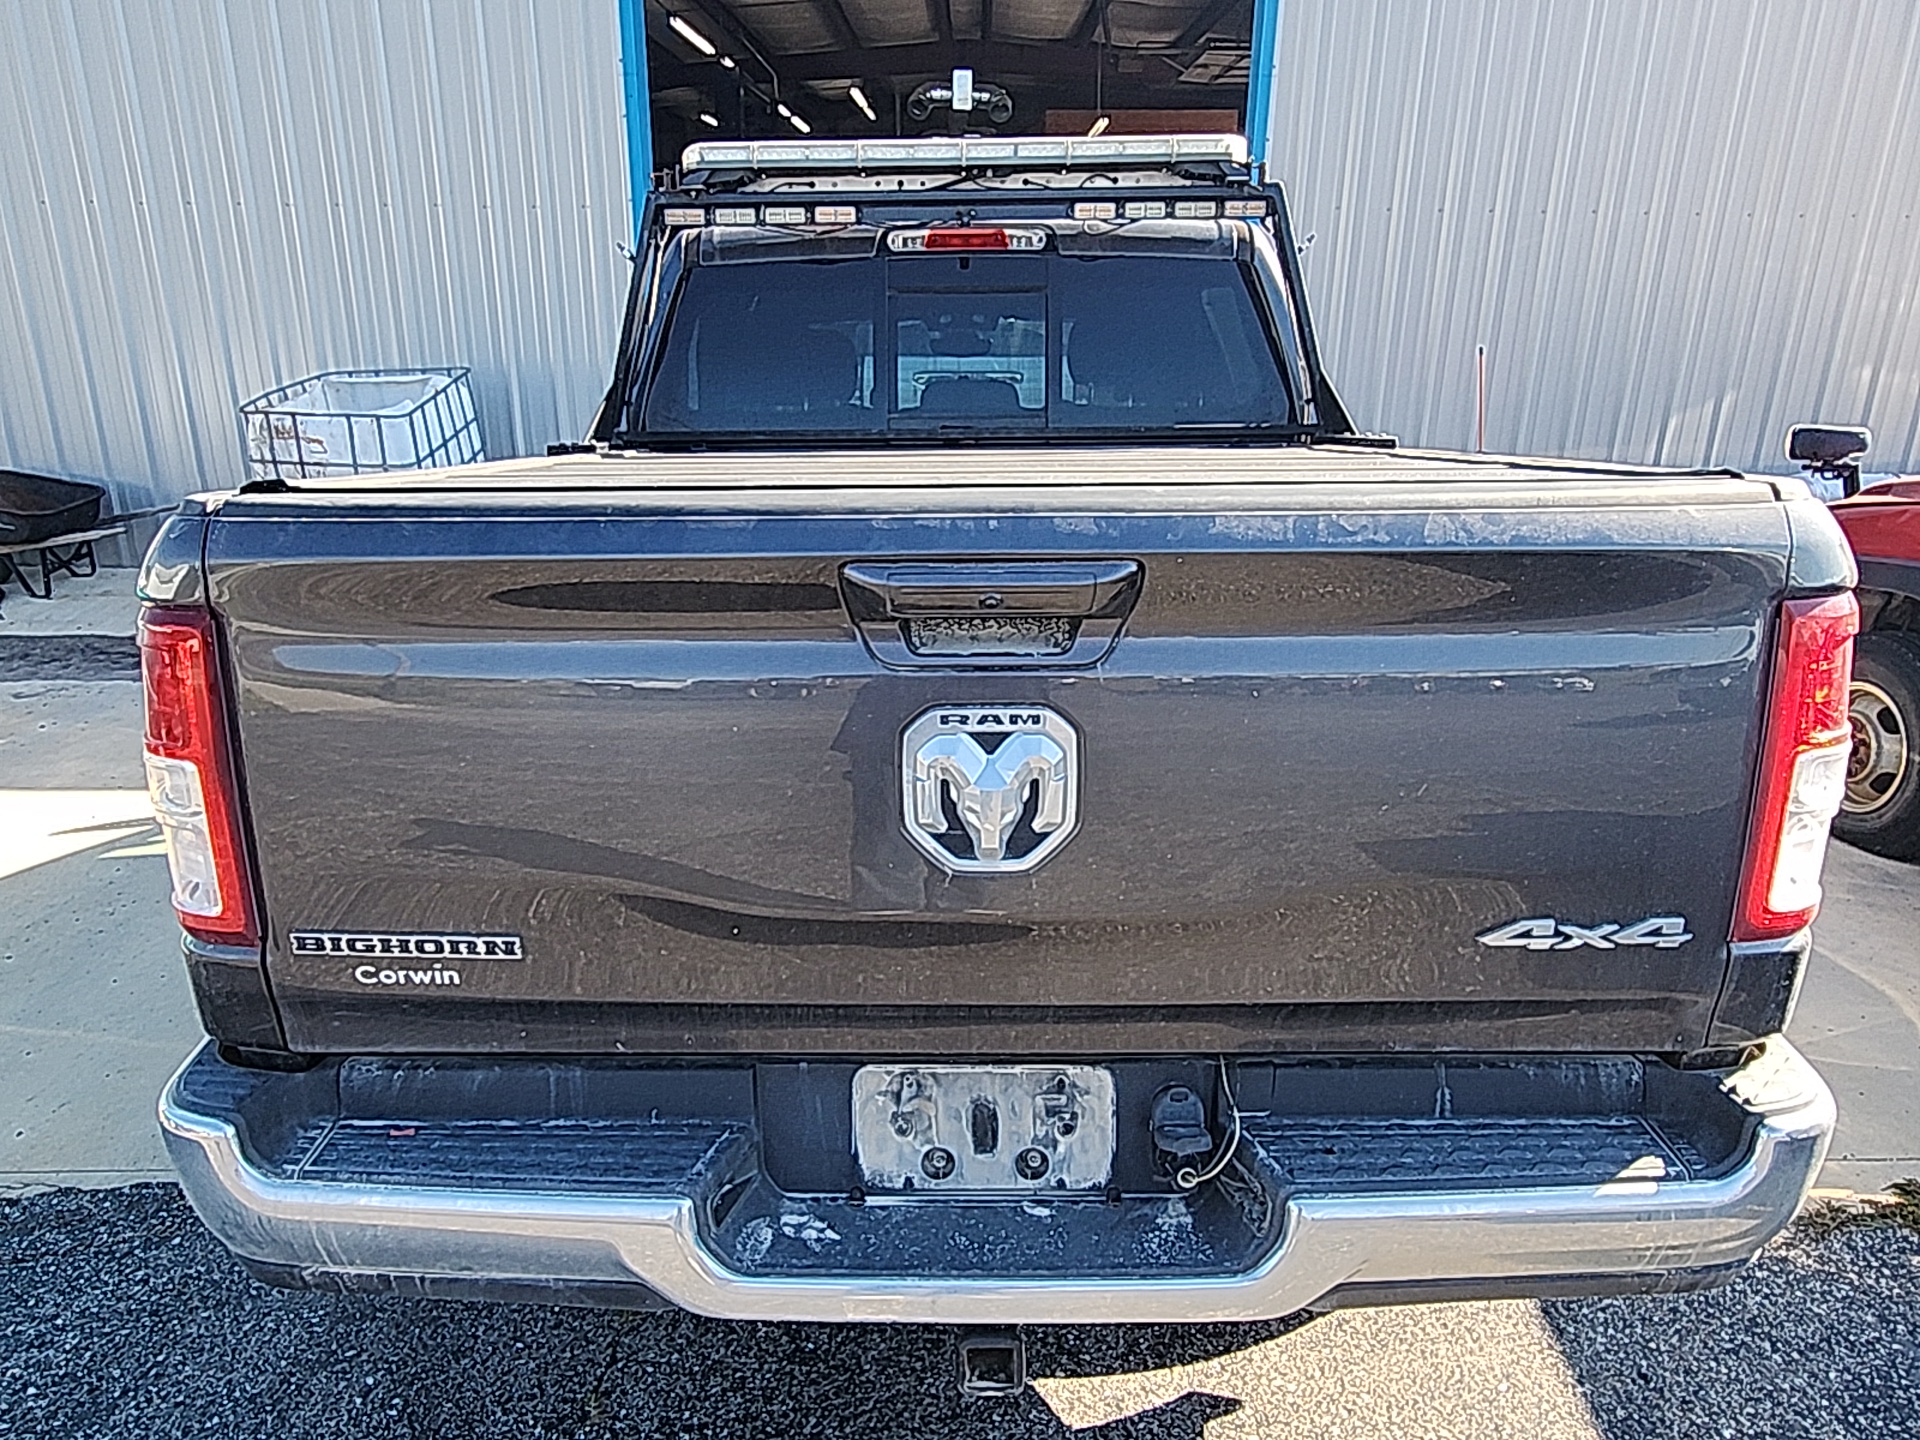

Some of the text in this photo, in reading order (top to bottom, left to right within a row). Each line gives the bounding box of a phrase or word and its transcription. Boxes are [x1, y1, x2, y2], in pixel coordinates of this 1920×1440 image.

[939, 714, 1041, 726] RAM
[290, 934, 522, 959] BIGHORN
[354, 963, 461, 985] Corwin
